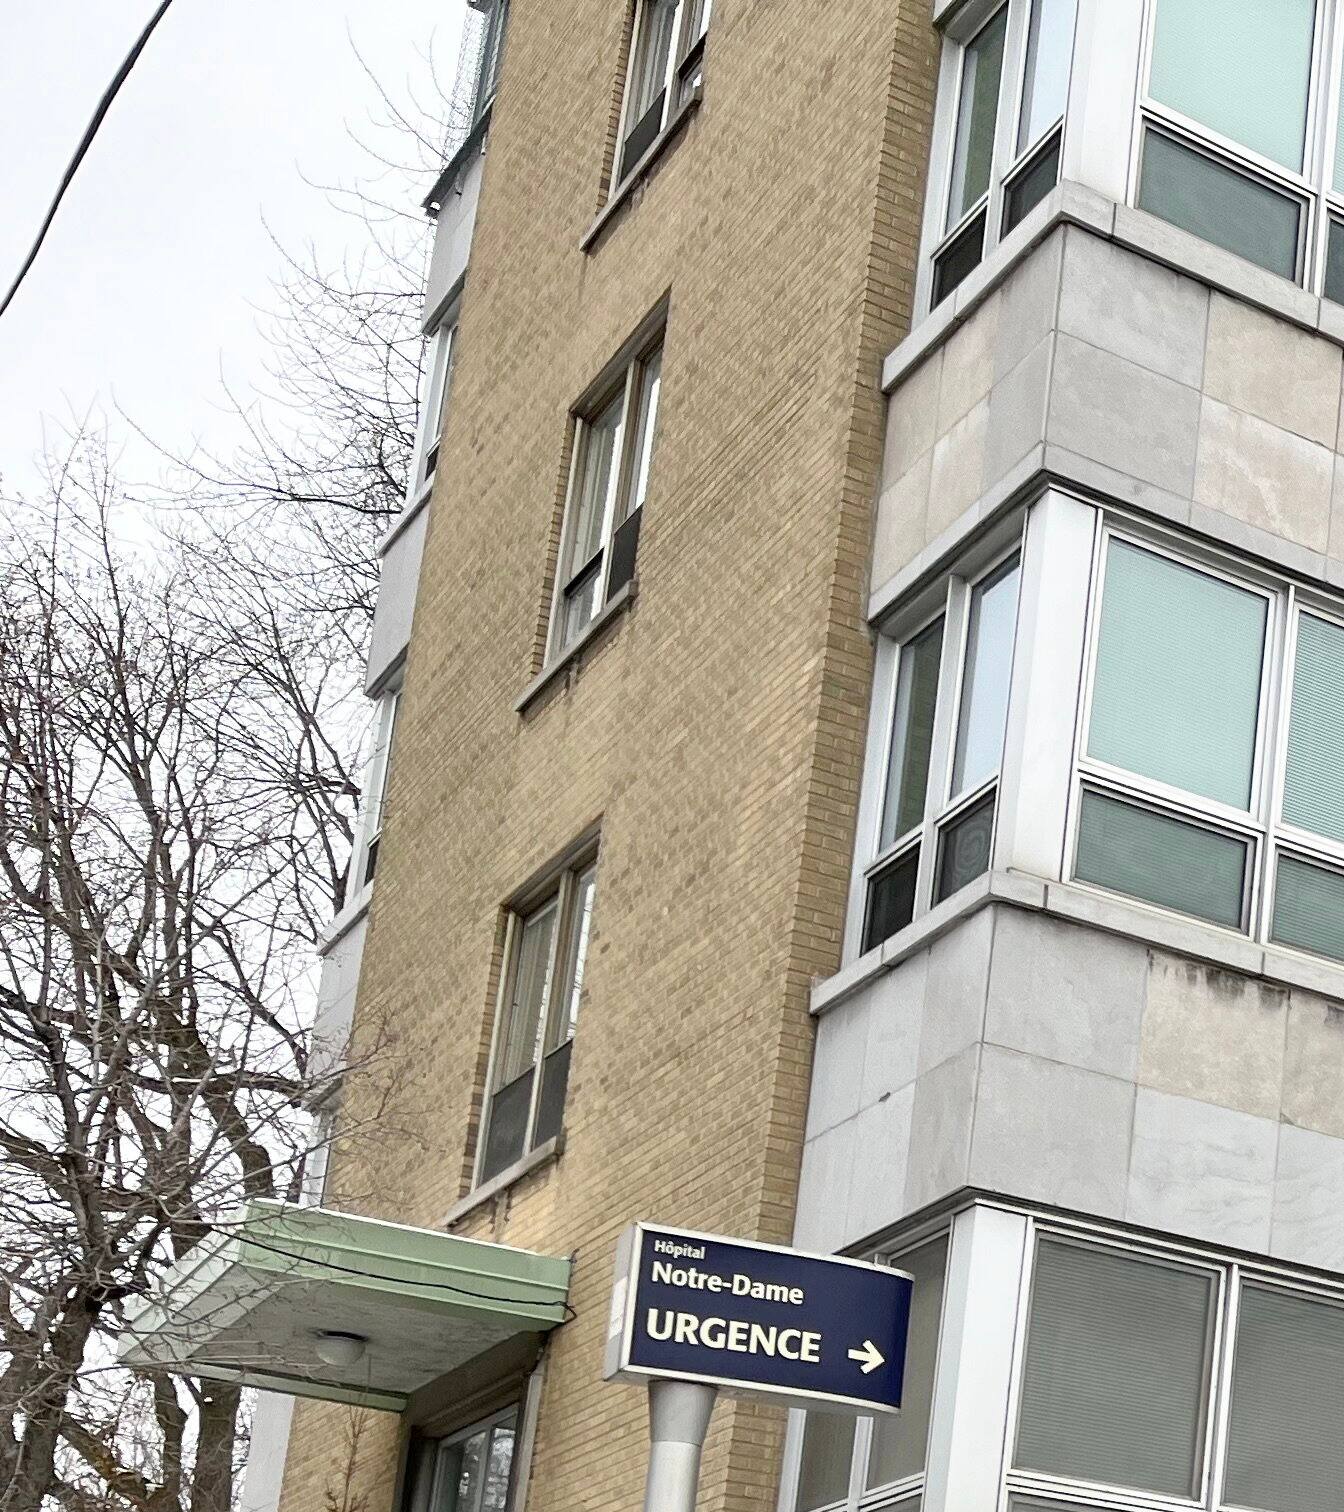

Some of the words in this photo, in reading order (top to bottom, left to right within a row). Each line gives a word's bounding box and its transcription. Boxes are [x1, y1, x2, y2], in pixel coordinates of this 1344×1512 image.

[654, 1239, 706, 1260] Hôpital
[651, 1261, 804, 1305] Notre-Dame
[646, 1307, 822, 1363] URGENCE
